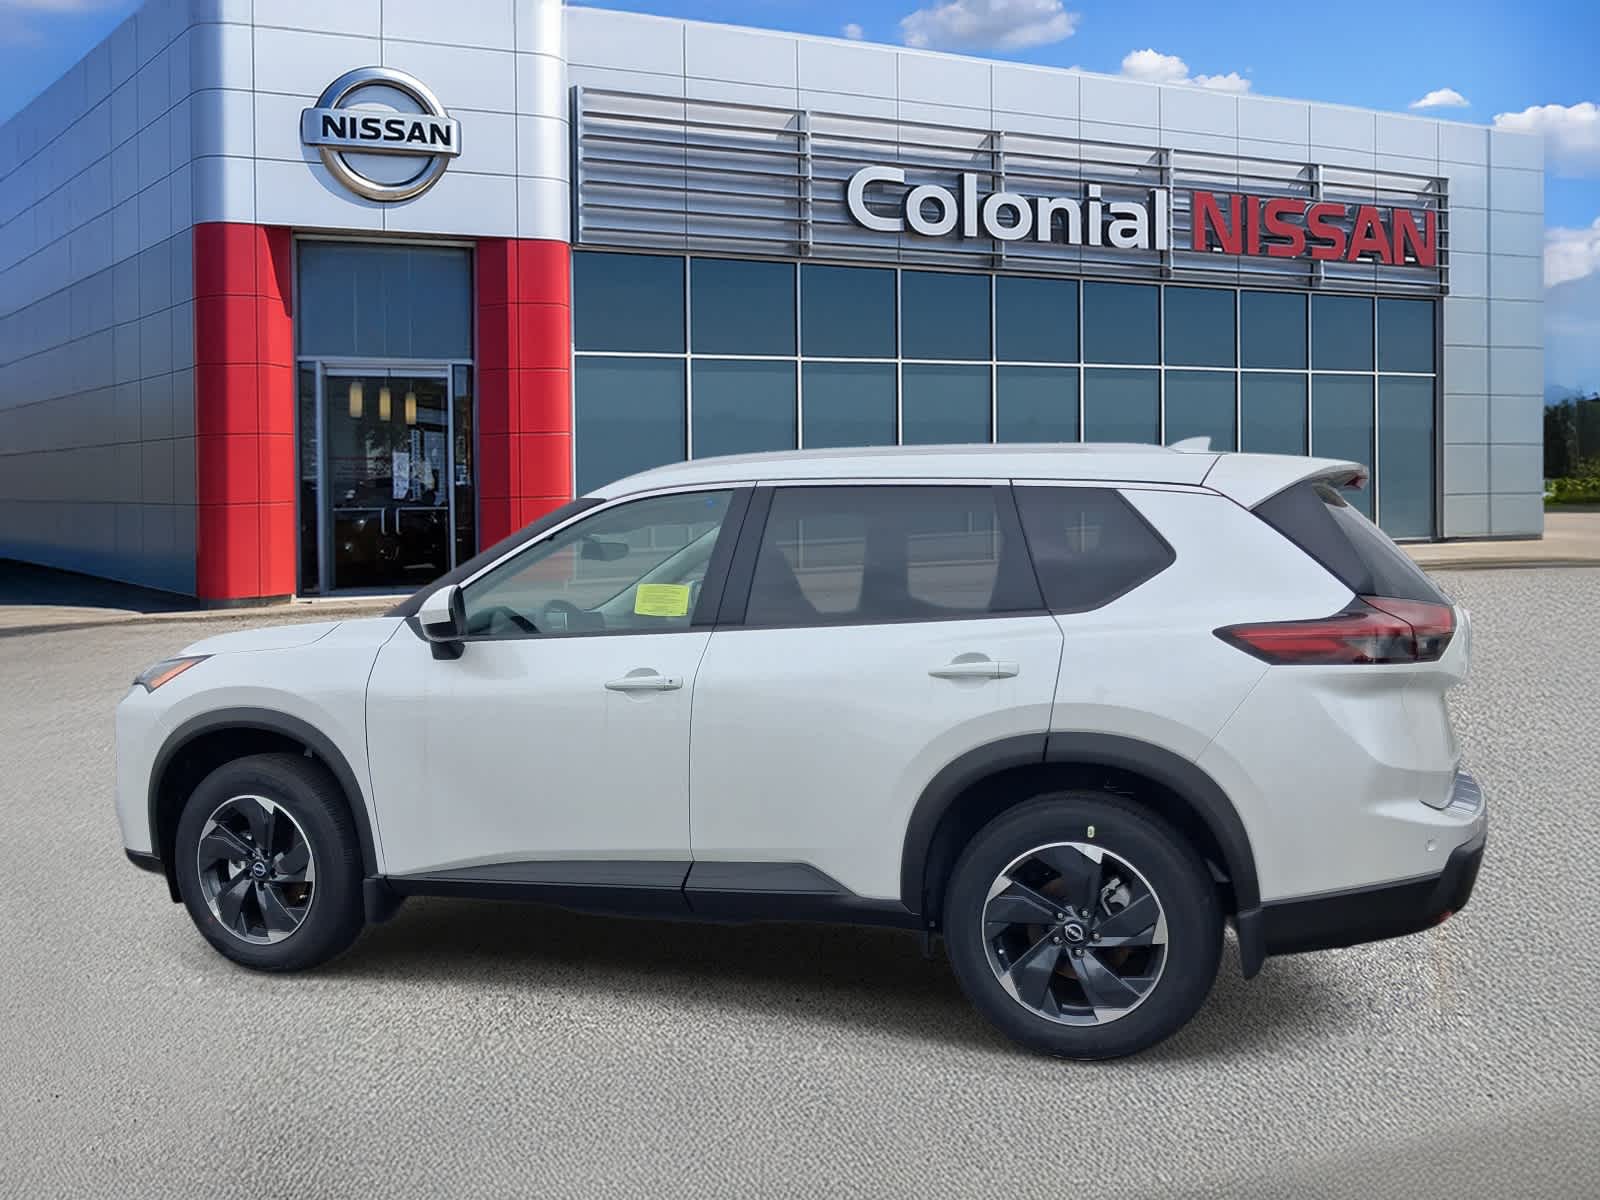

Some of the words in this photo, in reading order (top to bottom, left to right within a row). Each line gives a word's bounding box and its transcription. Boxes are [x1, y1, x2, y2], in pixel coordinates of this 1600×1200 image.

[321, 115, 451, 146] NISSAN
[847, 165, 1168, 250] Colonial
[1193, 191, 1436, 266] NISSAN
